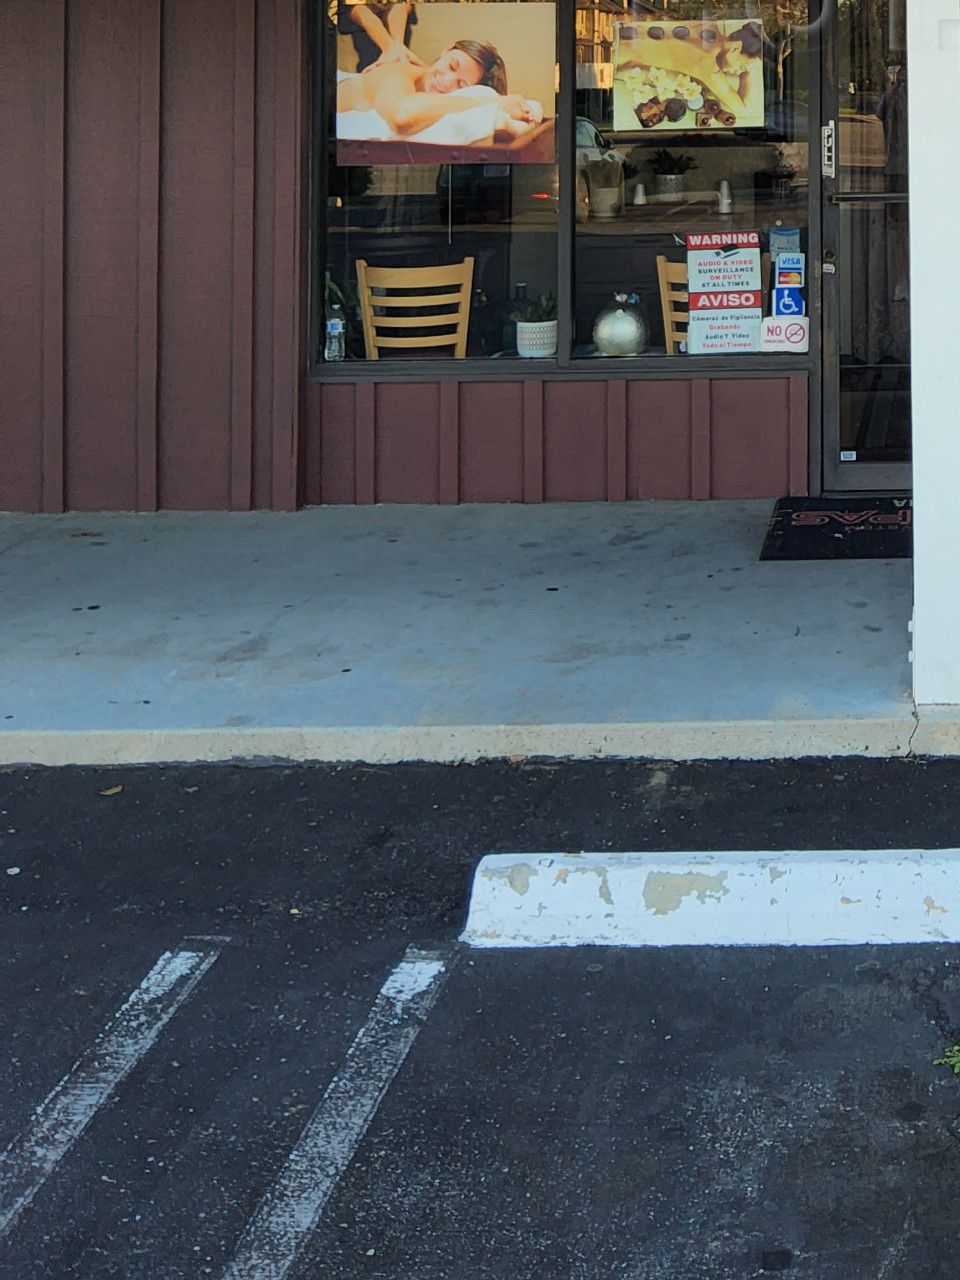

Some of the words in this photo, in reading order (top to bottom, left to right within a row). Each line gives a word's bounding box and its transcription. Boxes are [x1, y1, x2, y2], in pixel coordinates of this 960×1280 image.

[824, 129, 832, 165] PULL
[689, 232, 759, 246] WARNING
[782, 257, 801, 265] VISA
[697, 292, 755, 307] AVISO
[767, 325, 782, 337] NO
